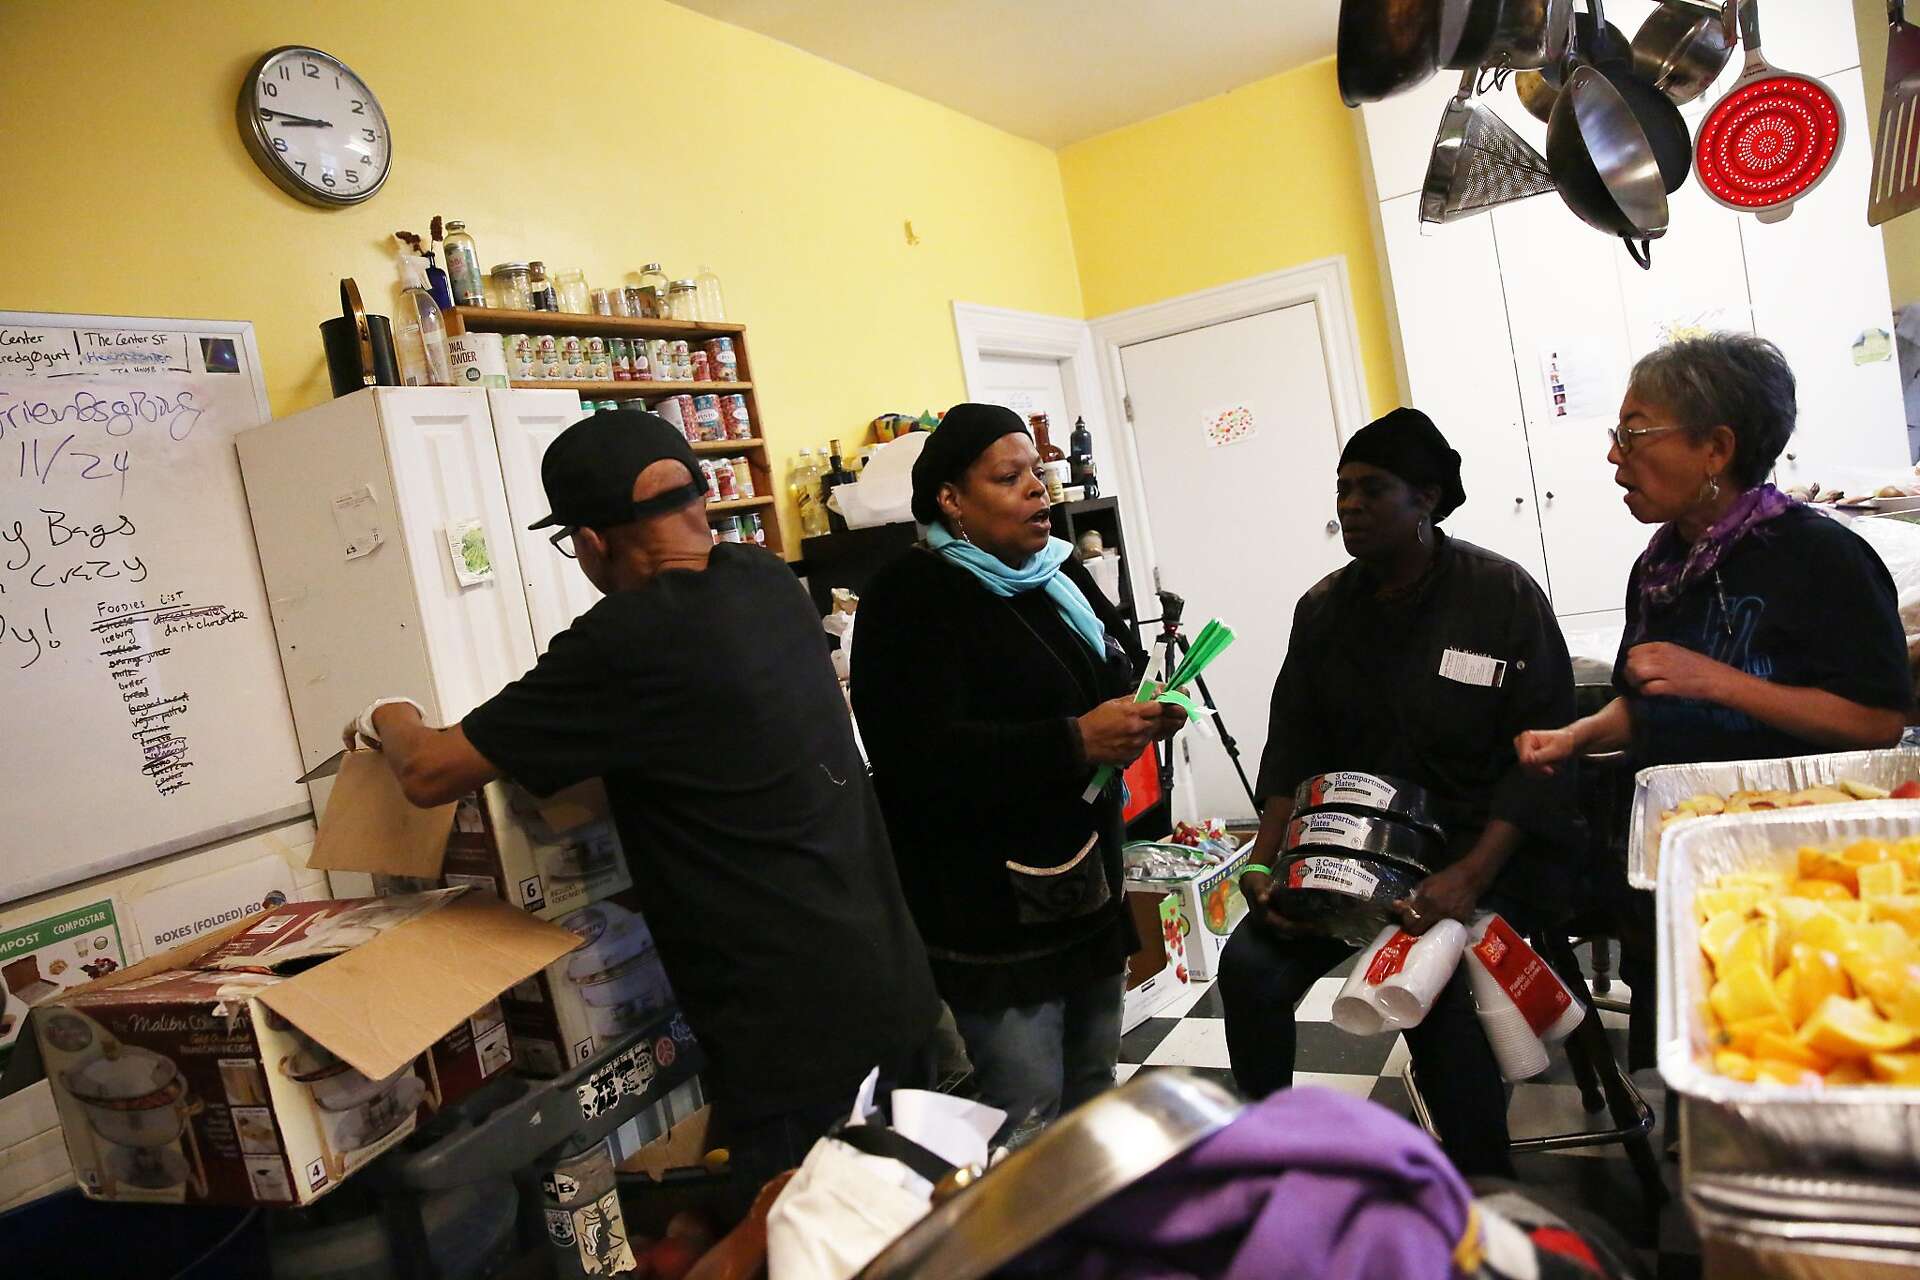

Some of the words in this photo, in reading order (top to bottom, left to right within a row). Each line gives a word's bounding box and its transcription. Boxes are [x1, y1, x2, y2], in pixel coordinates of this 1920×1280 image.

[279, 65, 290, 81] 11
[302, 62, 320, 79] 12
[262, 81, 278, 97] 10
[335, 77, 340, 90] 1
[260, 107, 274, 122] 9
[351, 100, 365, 115] 2
[362, 128, 376, 143] 3
[273, 137, 289, 152] 8
[295, 160, 307, 176] 7
[360, 155, 373, 167] 4
[321, 173, 336, 187] 6
[345, 169, 359, 183] 5
[0, 330, 44, 347] Center
[84, 332, 113, 347] The
[115, 333, 148, 347] Center
[152, 334, 168, 346] SF
[19, 434, 129, 499] 11/24
[40, 508, 136, 548] Bags
[165, 623, 194, 637] dark
[1334, 779, 1356, 788] Plates
[1335, 773, 1341, 781] 3
[1341, 772, 1392, 795] Compartment
[1310, 820, 1330, 829] Plates
[1316, 812, 1366, 832] Compartme
[527, 882, 536, 897] 6
[53, 911, 106, 936] COMPOSTAR
[154, 925, 192, 945] BOXES
[193, 907, 244, 934] (FOLDED)
[245, 901, 261, 915] GO
[128, 1012, 188, 1033] Malibu
[581, 1046, 589, 1060] 6
[312, 1164, 321, 1179] 4
